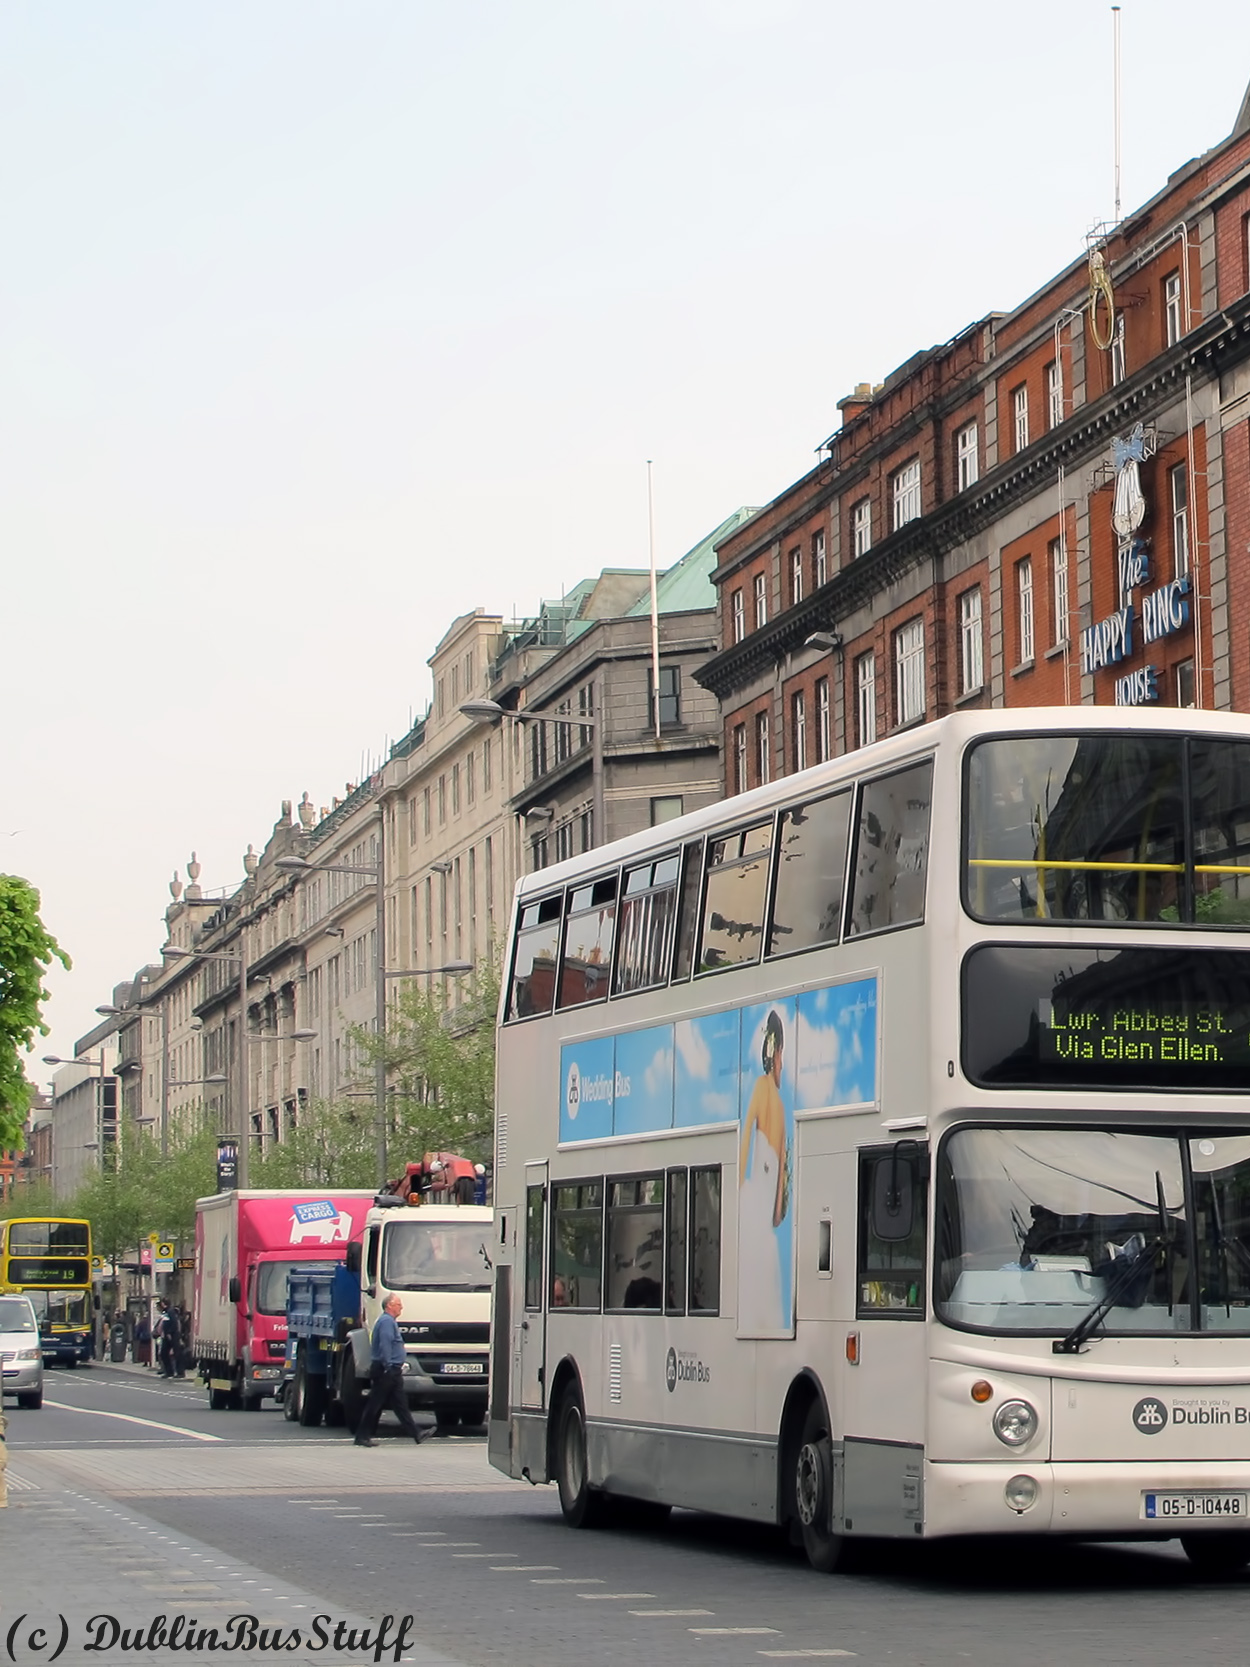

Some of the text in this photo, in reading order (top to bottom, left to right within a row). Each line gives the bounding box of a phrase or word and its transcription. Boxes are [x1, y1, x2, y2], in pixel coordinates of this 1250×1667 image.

[1118, 540, 1147, 592] The
[1083, 578, 1187, 674] HAPPY RING
[1114, 664, 1155, 706] HOUSE
[1051, 1005, 1233, 1033] Lwr. Abbey St.
[1056, 1034, 1224, 1061] Via Glen Ellen.
[582, 1071, 631, 1106] Wedding Bus
[298, 1204, 331, 1214] EXPRESS
[301, 1209, 335, 1221] CARGO
[62, 1270, 75, 1280] 19
[273, 1324, 289, 1332] Frie
[398, 1326, 430, 1334] DAF
[678, 1359, 710, 1383] Dublin Bus
[1172, 1407, 1231, 1424] Dublin
[1162, 1498, 1240, 1515] 05-D-10448
